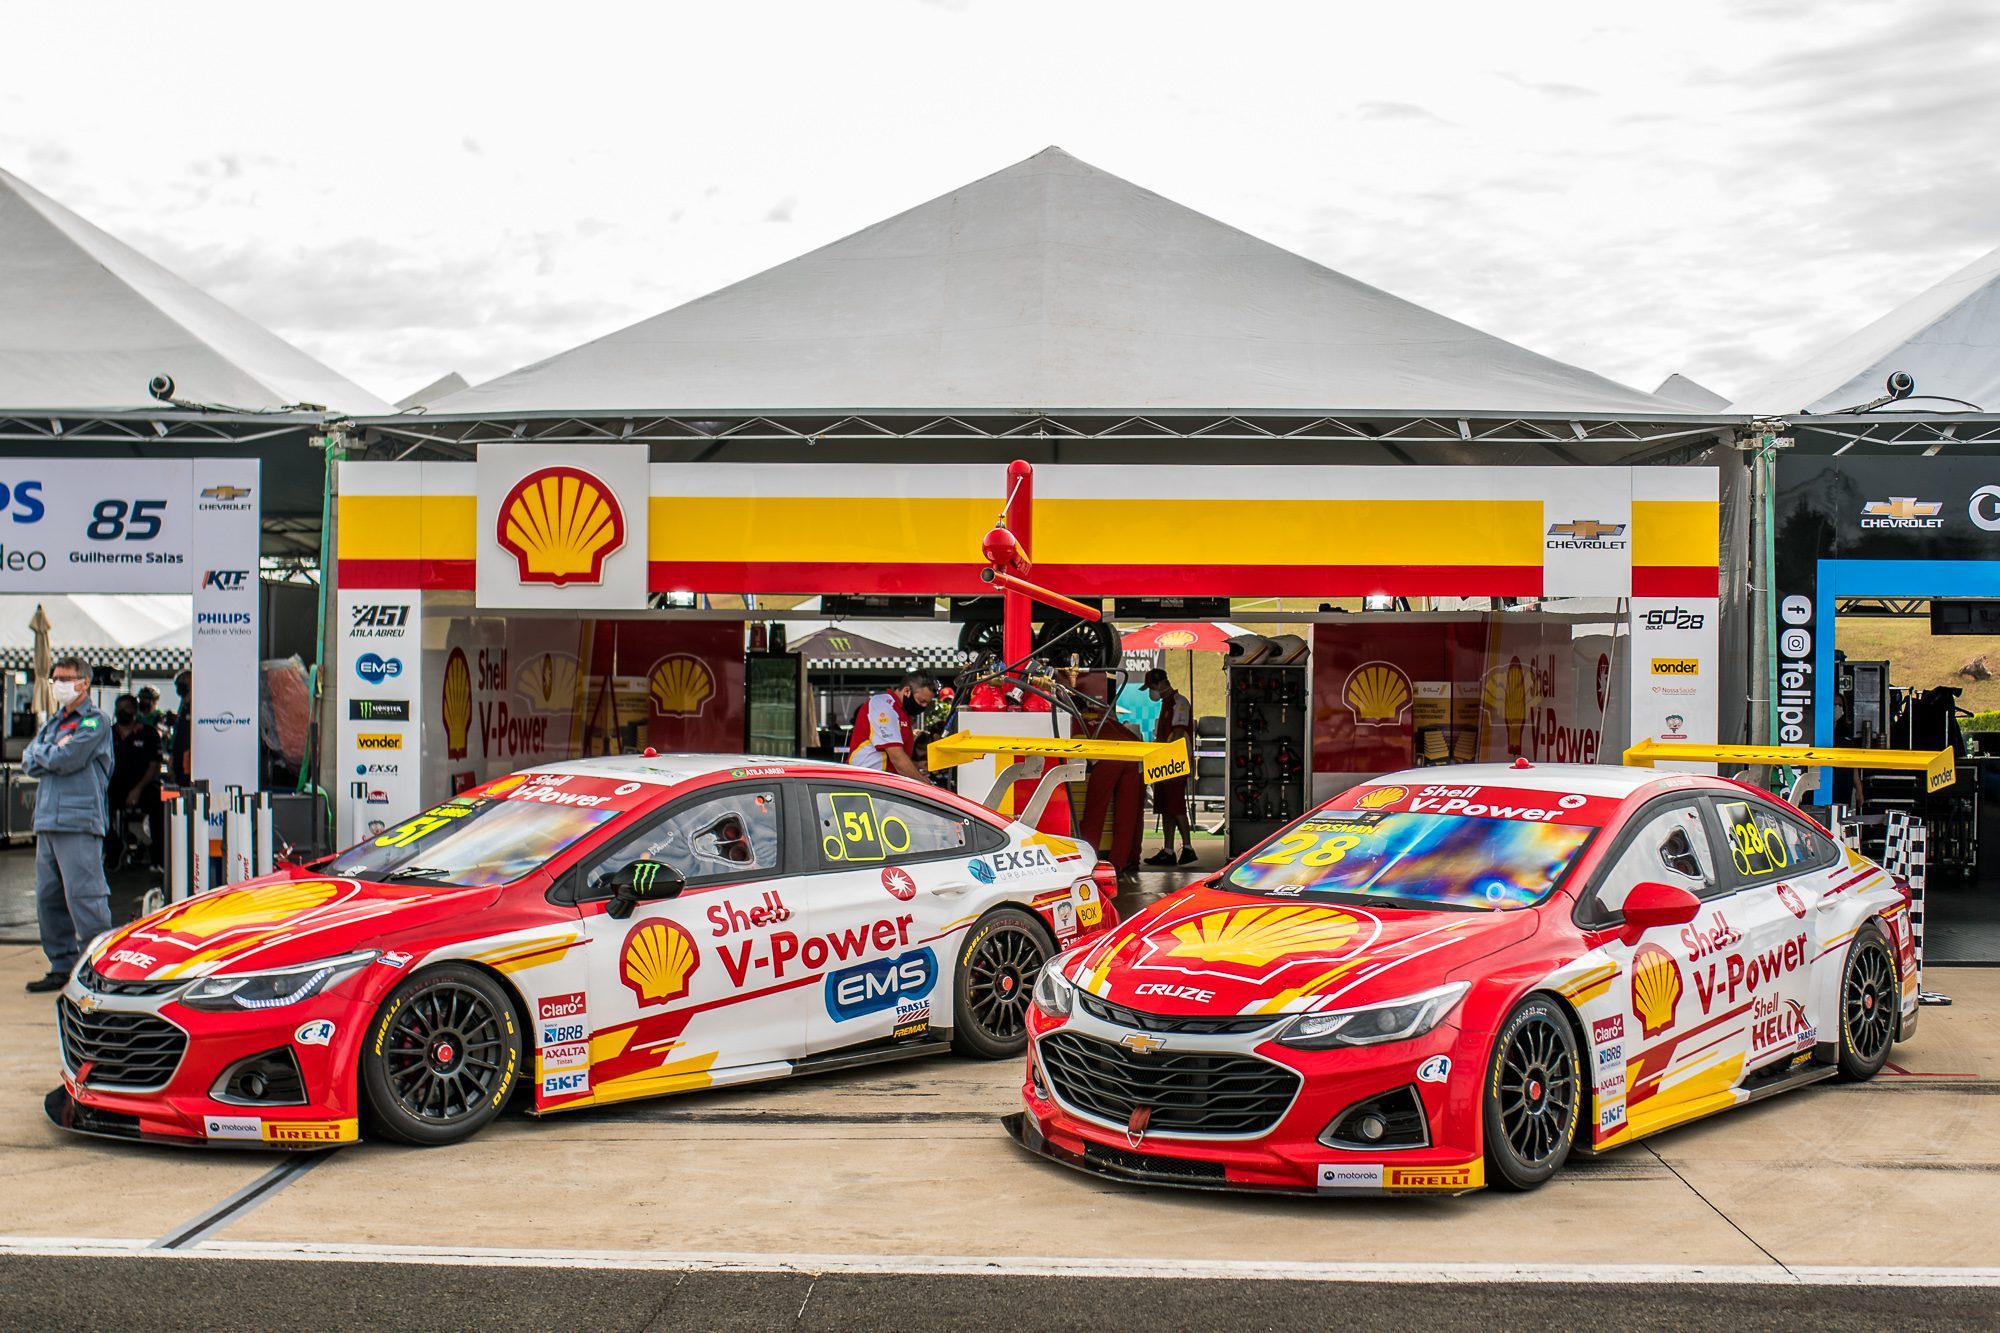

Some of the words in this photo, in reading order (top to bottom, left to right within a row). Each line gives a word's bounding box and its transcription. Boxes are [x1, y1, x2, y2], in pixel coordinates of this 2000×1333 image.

[199, 503, 252, 511] CHEVROLET
[87, 499, 168, 541] 85
[1860, 518, 1944, 528] CHEVROLET
[1547, 540, 1627, 549] CHEVROLET
[69, 552, 142, 564] Guilherme
[145, 552, 184, 564] Salas
[197, 612, 251, 624] PHILIPS
[375, 628, 405, 638] ABREU
[360, 662, 398, 674] EMS
[479, 647, 508, 691] Shell
[1530, 654, 1556, 698] Shell
[1653, 661, 1697, 674] vonder
[478, 701, 548, 759] V-Power
[1530, 706, 1604, 764] V-Power
[358, 736, 400, 748] vonder
[368, 764, 398, 773] EXSA
[1147, 759, 1187, 781] vonder
[1930, 767, 1954, 789] vonder
[529, 775, 575, 788] Shell
[507, 785, 613, 808] V-Power
[1417, 785, 1482, 798] Shell
[1405, 797, 1565, 821] V-Power
[843, 811, 876, 843] 51
[1735, 822, 1764, 855] 28
[1251, 833, 1361, 867] 28
[993, 849, 1052, 873] EXSA
[706, 890, 785, 938] Shell
[1081, 907, 1097, 921] BOX
[1680, 910, 1742, 962] Shell
[716, 913, 914, 988] V-Power
[963, 926, 989, 967] PIRELLI
[109, 949, 158, 969] CRUZE
[837, 958, 927, 1006] EMS
[1692, 931, 1808, 1016] V-Power
[1134, 983, 1217, 1003] CRUZE
[541, 1002, 578, 1017] Claro
[1753, 991, 1779, 1020] Shell
[375, 998, 401, 1057] PIRELLI
[557, 1024, 584, 1042] BRB
[893, 1022, 928, 1039] FREMAX
[1594, 1027, 1618, 1042] Claro
[1751, 1000, 1810, 1052] HELIX
[544, 1046, 587, 1060] AXALTA
[1606, 1045, 1622, 1062] BRB
[545, 1074, 586, 1092] SKF
[1600, 1074, 1625, 1092] AXALTA
[1601, 1104, 1625, 1126] SKF
[221, 1121, 257, 1132] motorola
[269, 1124, 340, 1140] PIRELLI
[1337, 1170, 1378, 1179] motorola
[1391, 1168, 1470, 1185] PIRELLI
